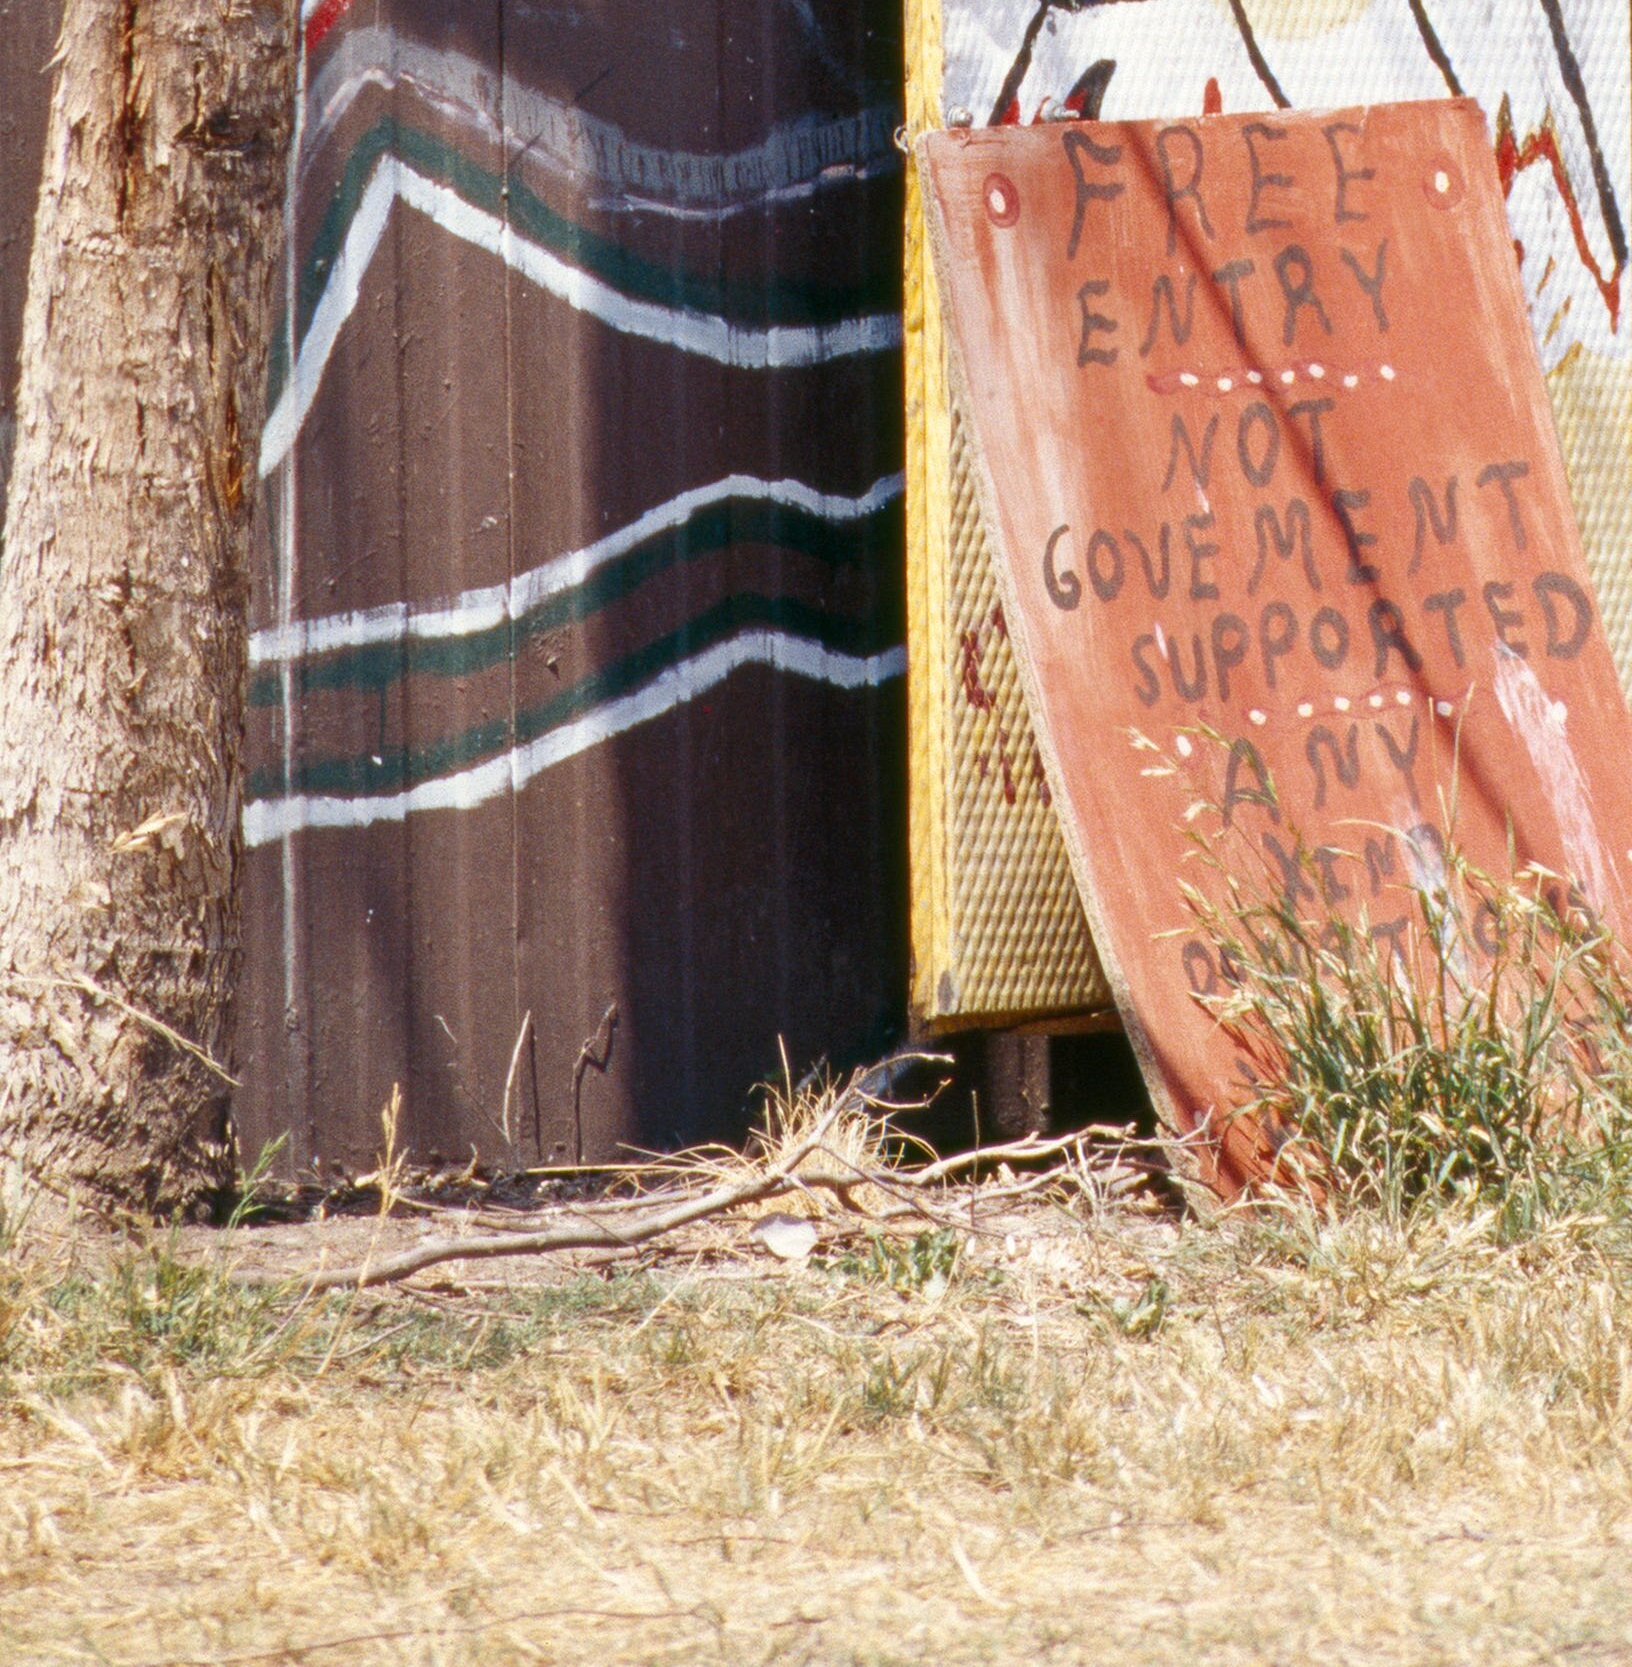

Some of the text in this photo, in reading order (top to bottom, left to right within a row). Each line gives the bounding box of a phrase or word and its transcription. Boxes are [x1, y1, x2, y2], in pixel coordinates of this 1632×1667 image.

[1062, 120, 1378, 261] FREE
[1075, 237, 1391, 370] ENTRY
[1161, 396, 1336, 495] NOT
[1042, 460, 1531, 612] GOVEMENT
[1130, 569, 1597, 710] SUPPORTED
[1221, 715, 1421, 828] ANY
